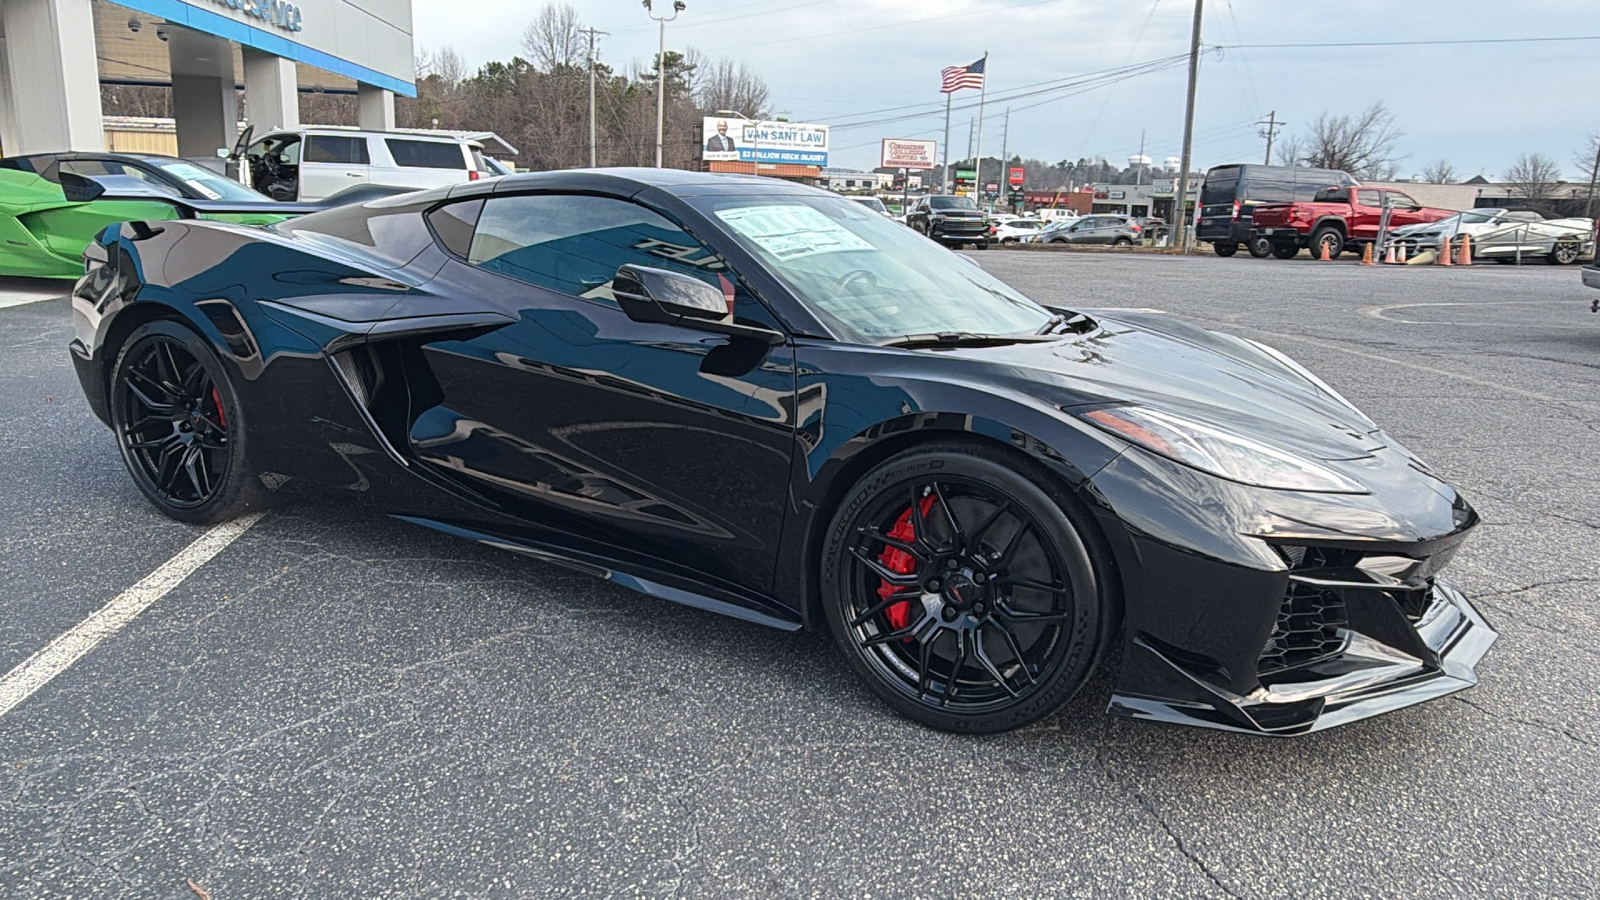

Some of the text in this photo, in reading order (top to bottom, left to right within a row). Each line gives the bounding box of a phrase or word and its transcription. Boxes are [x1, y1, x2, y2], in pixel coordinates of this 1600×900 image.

[746, 129, 822, 143] VAN SANT LAW
[751, 151, 781, 160] MILLION
[781, 153, 801, 161] NECK
[801, 154, 827, 162] INJURY
[833, 488, 868, 542] MICHELIN
[882, 646, 920, 680] CORVETTE
